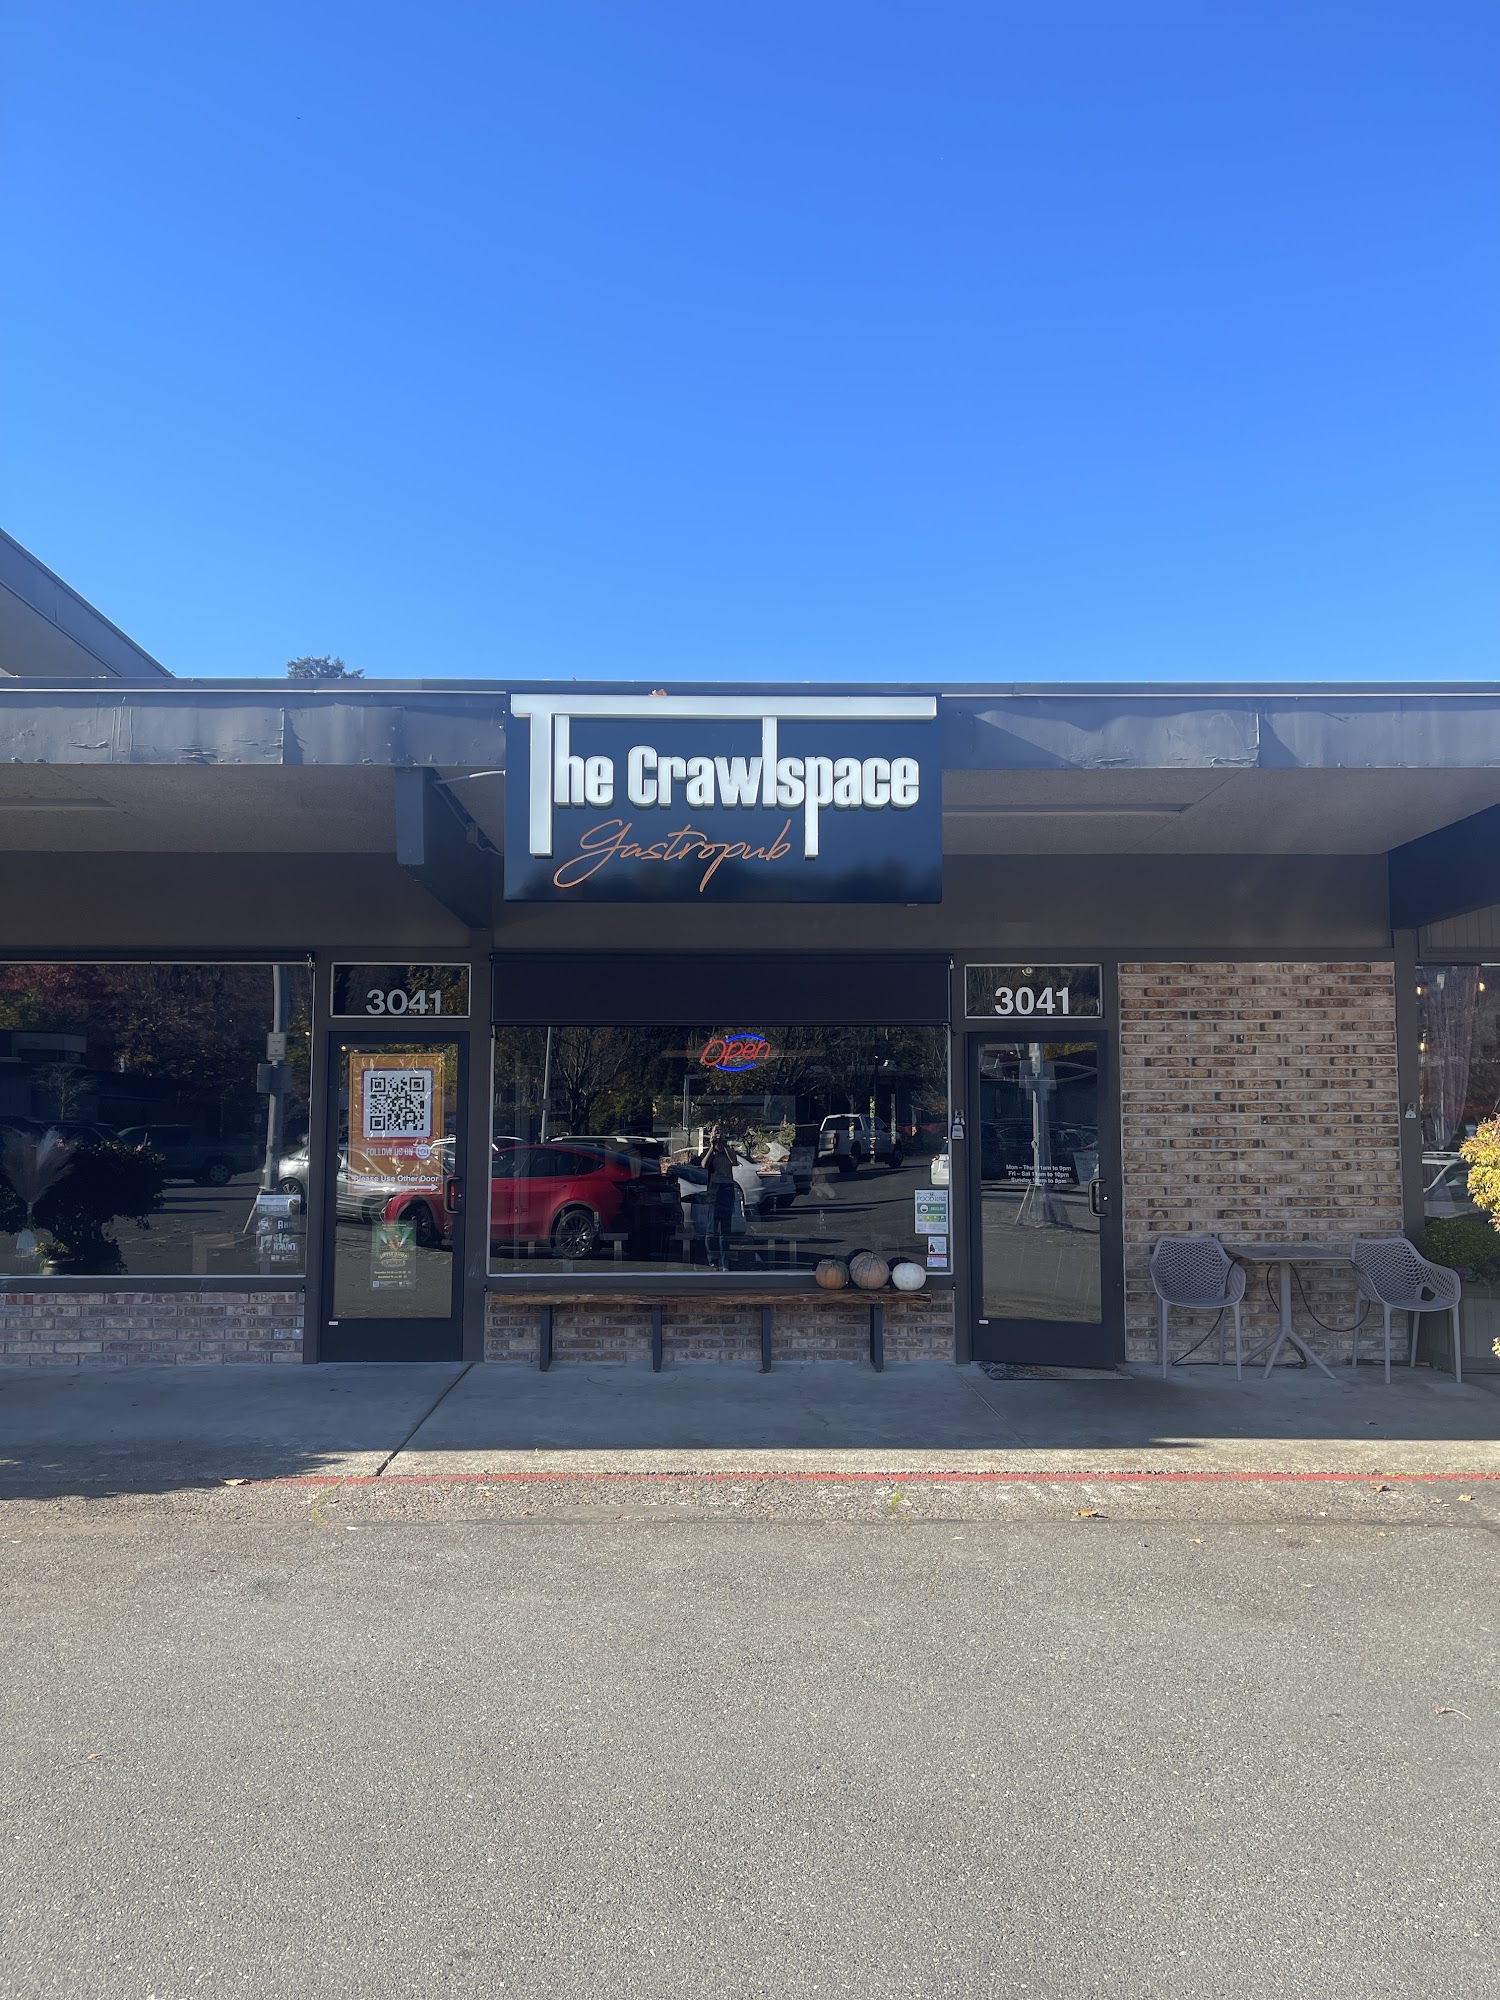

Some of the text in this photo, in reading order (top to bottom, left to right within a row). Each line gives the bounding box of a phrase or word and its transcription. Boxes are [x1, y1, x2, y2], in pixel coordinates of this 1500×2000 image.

[627, 716, 921, 860] Crawlspace
[553, 818, 793, 893] Gastropub
[366, 989, 441, 1014] 3041
[994, 986, 1069, 1015] 3041
[702, 1039, 771, 1067] Open
[366, 1147, 414, 1157] FOLLOW US ON
[353, 1174, 439, 1183] Please Use Other Door
[1059, 1165, 1072, 1173] 9pm
